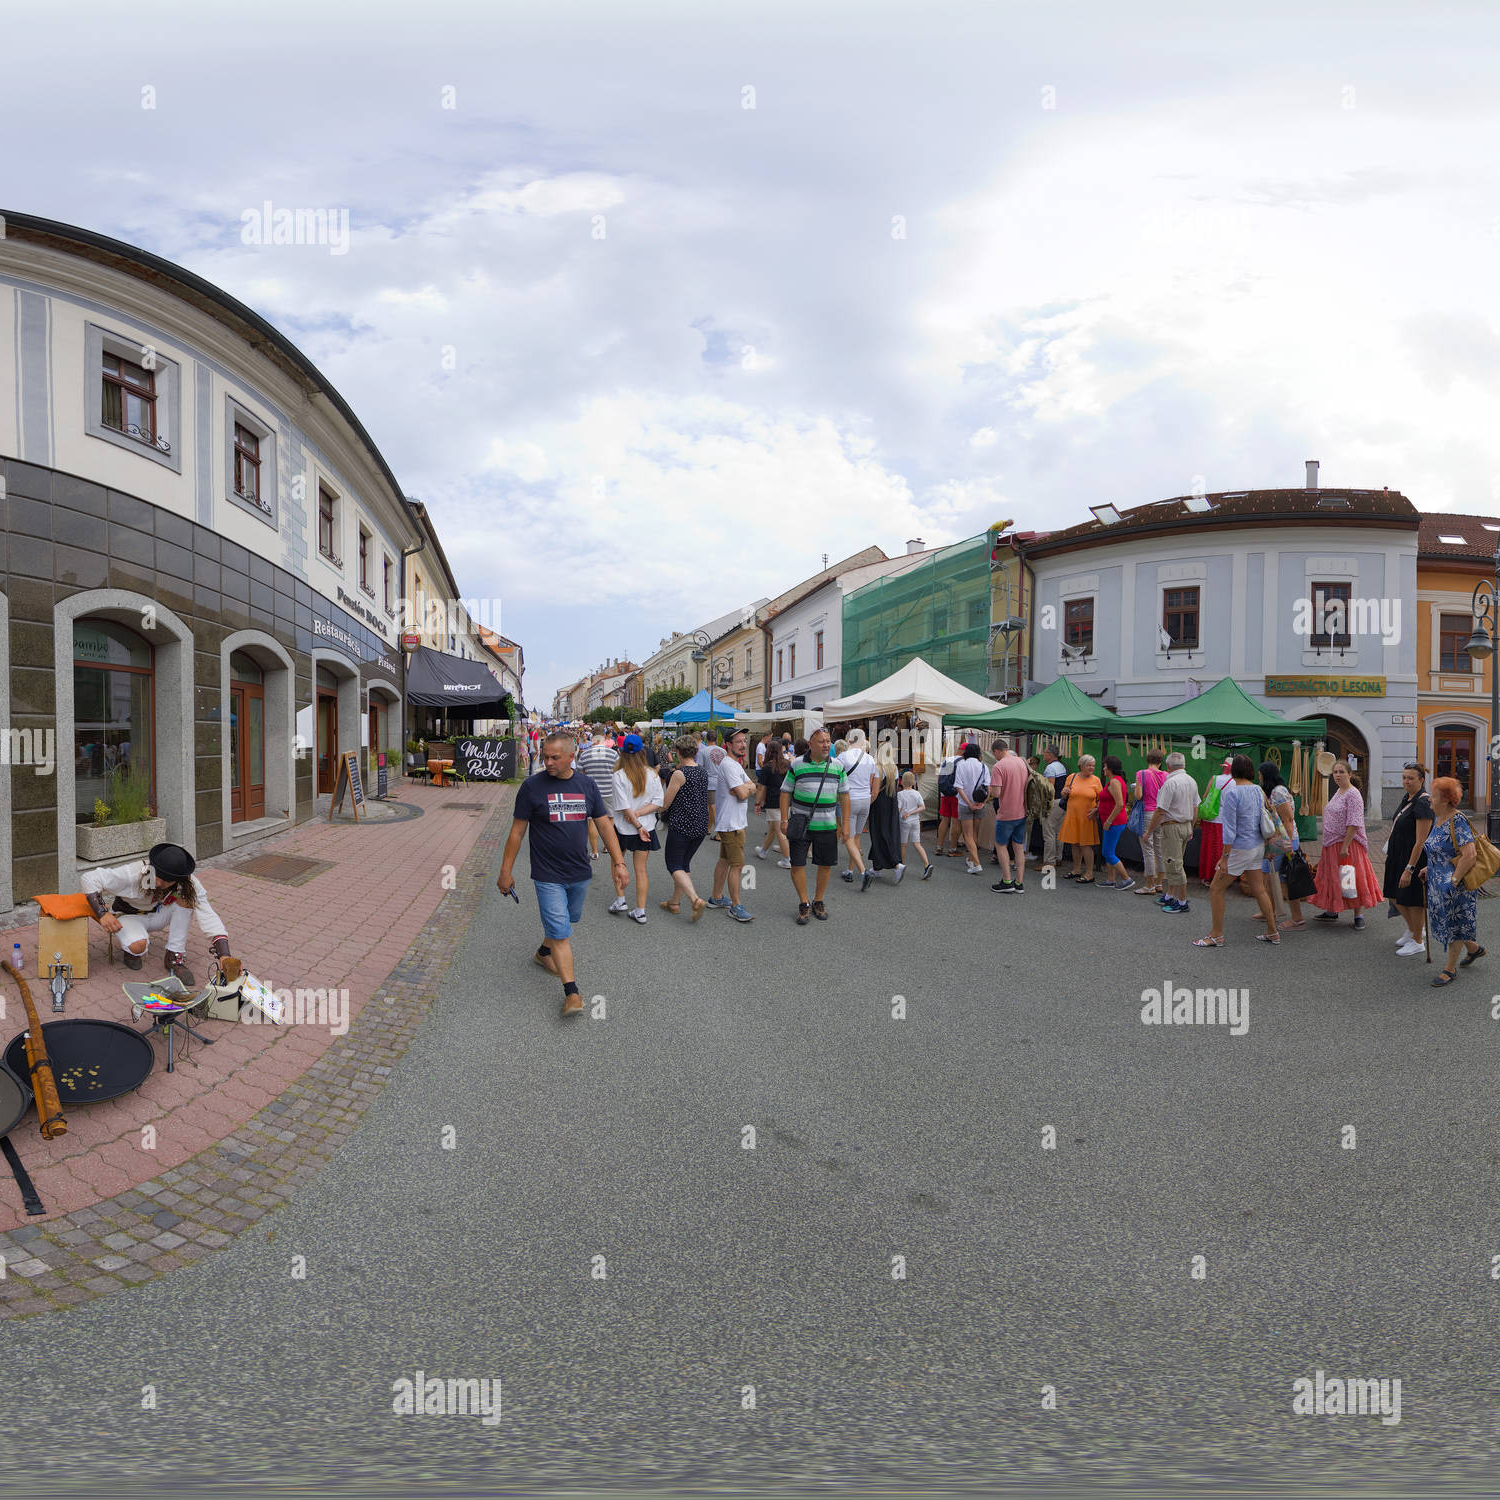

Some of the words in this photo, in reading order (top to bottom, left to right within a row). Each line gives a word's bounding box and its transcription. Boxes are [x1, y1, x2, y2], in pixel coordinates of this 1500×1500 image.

[366, 608, 388, 637] BOCA
[313, 619, 361, 658] Reštaurácia
[1342, 679, 1382, 693] LESONA
[460, 741, 509, 760] Mahalo
